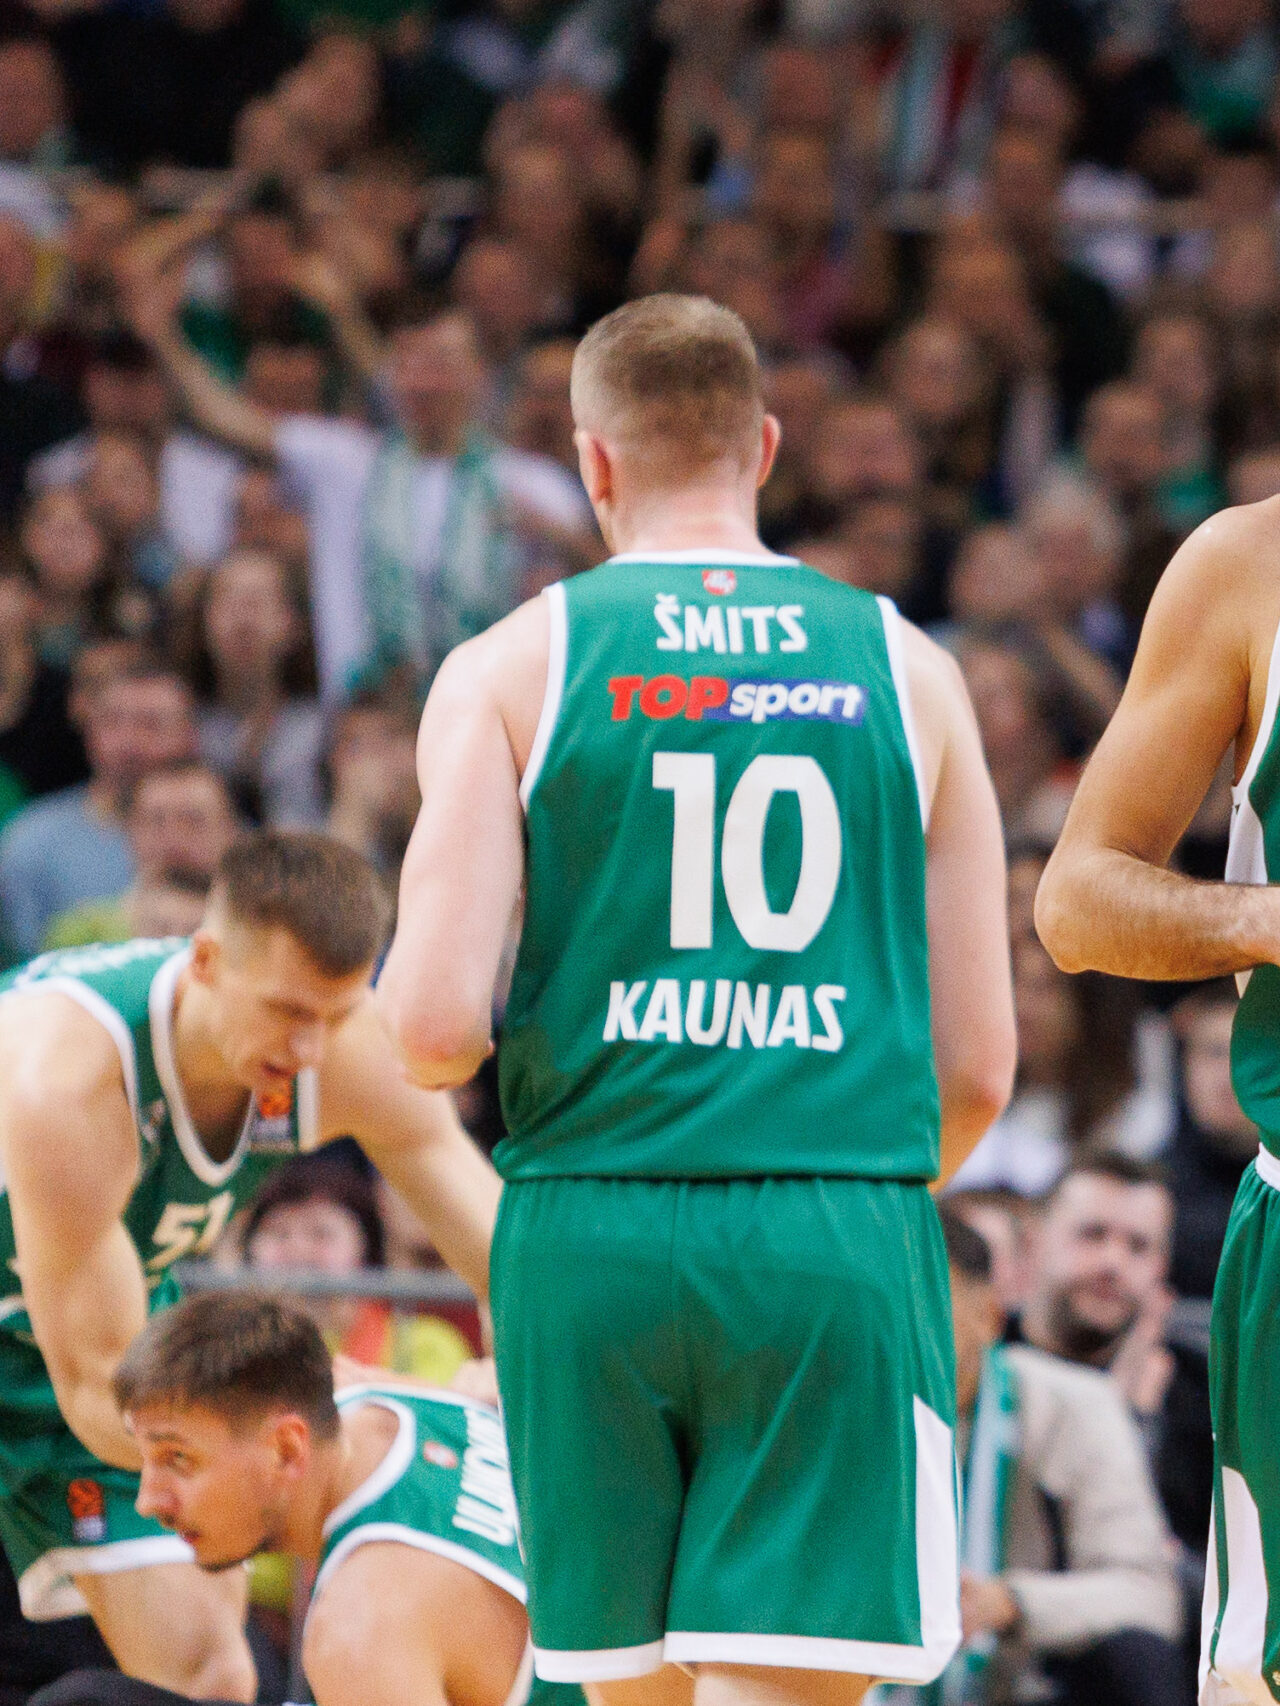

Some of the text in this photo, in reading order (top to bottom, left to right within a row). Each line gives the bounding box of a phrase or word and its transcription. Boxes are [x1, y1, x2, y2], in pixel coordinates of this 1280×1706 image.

[654, 593, 807, 654] ŠMITS
[607, 674, 863, 724] TOPsport
[652, 751, 842, 953] 10
[602, 979, 847, 1053] KAUNAS
[146, 1192, 236, 1270] 51
